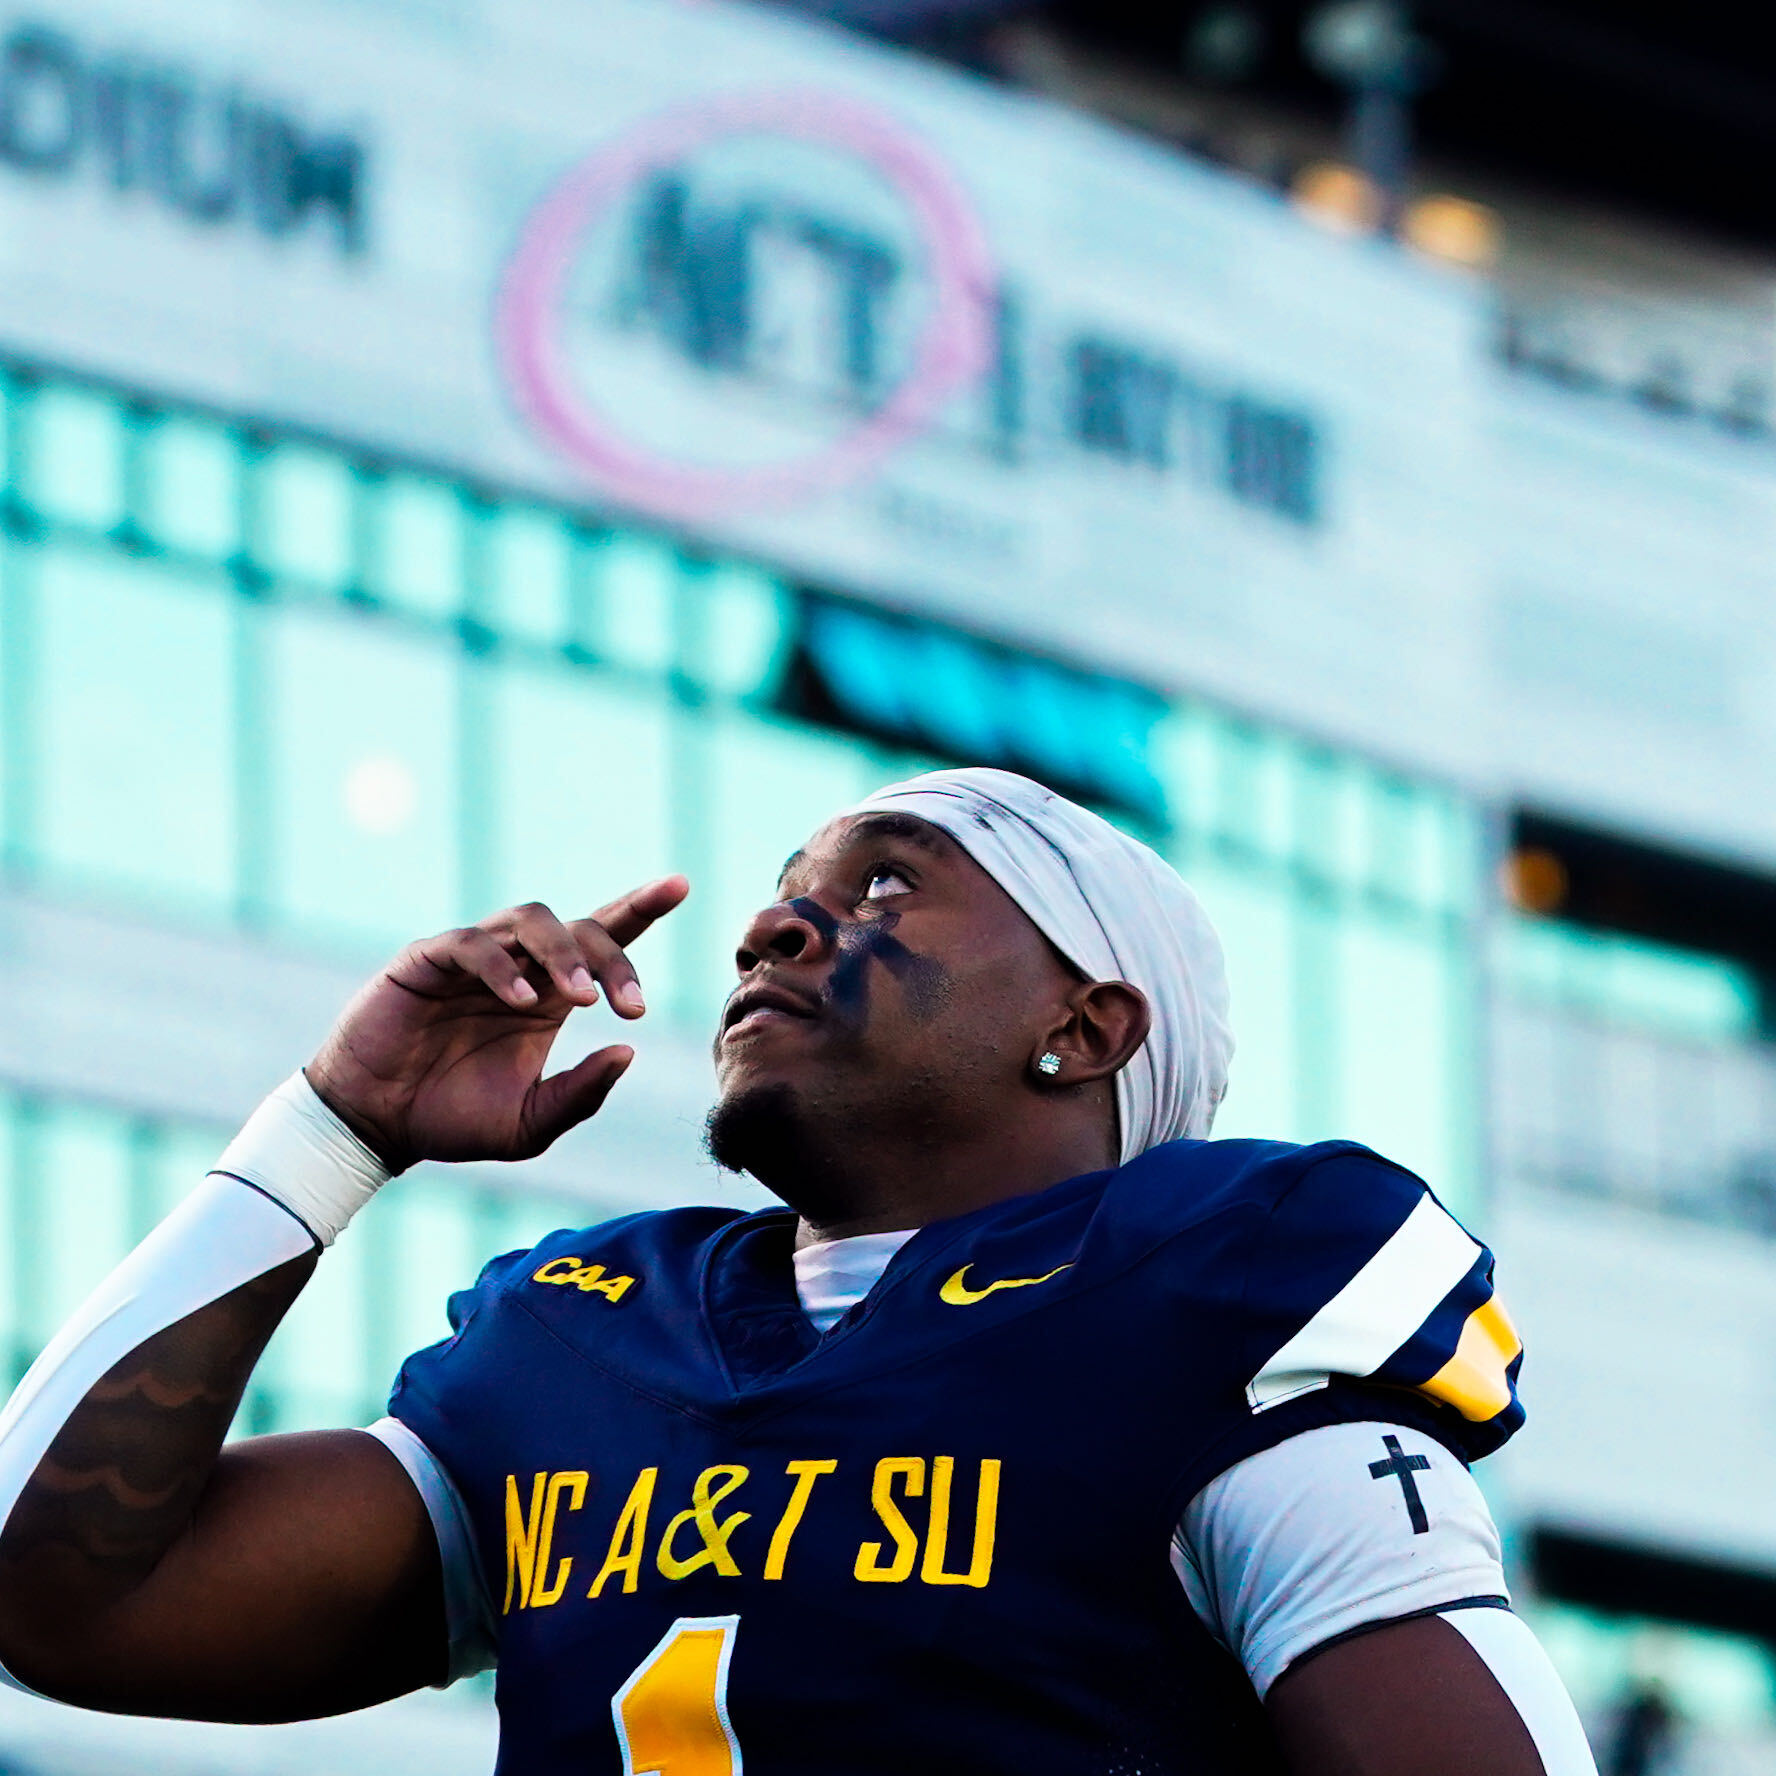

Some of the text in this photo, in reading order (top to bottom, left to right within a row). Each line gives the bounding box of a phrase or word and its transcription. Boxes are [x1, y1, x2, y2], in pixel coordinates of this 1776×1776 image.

[533, 1256, 636, 1304] CAA
[502, 1470, 590, 1615] NC
[853, 1456, 1002, 1588] SU
